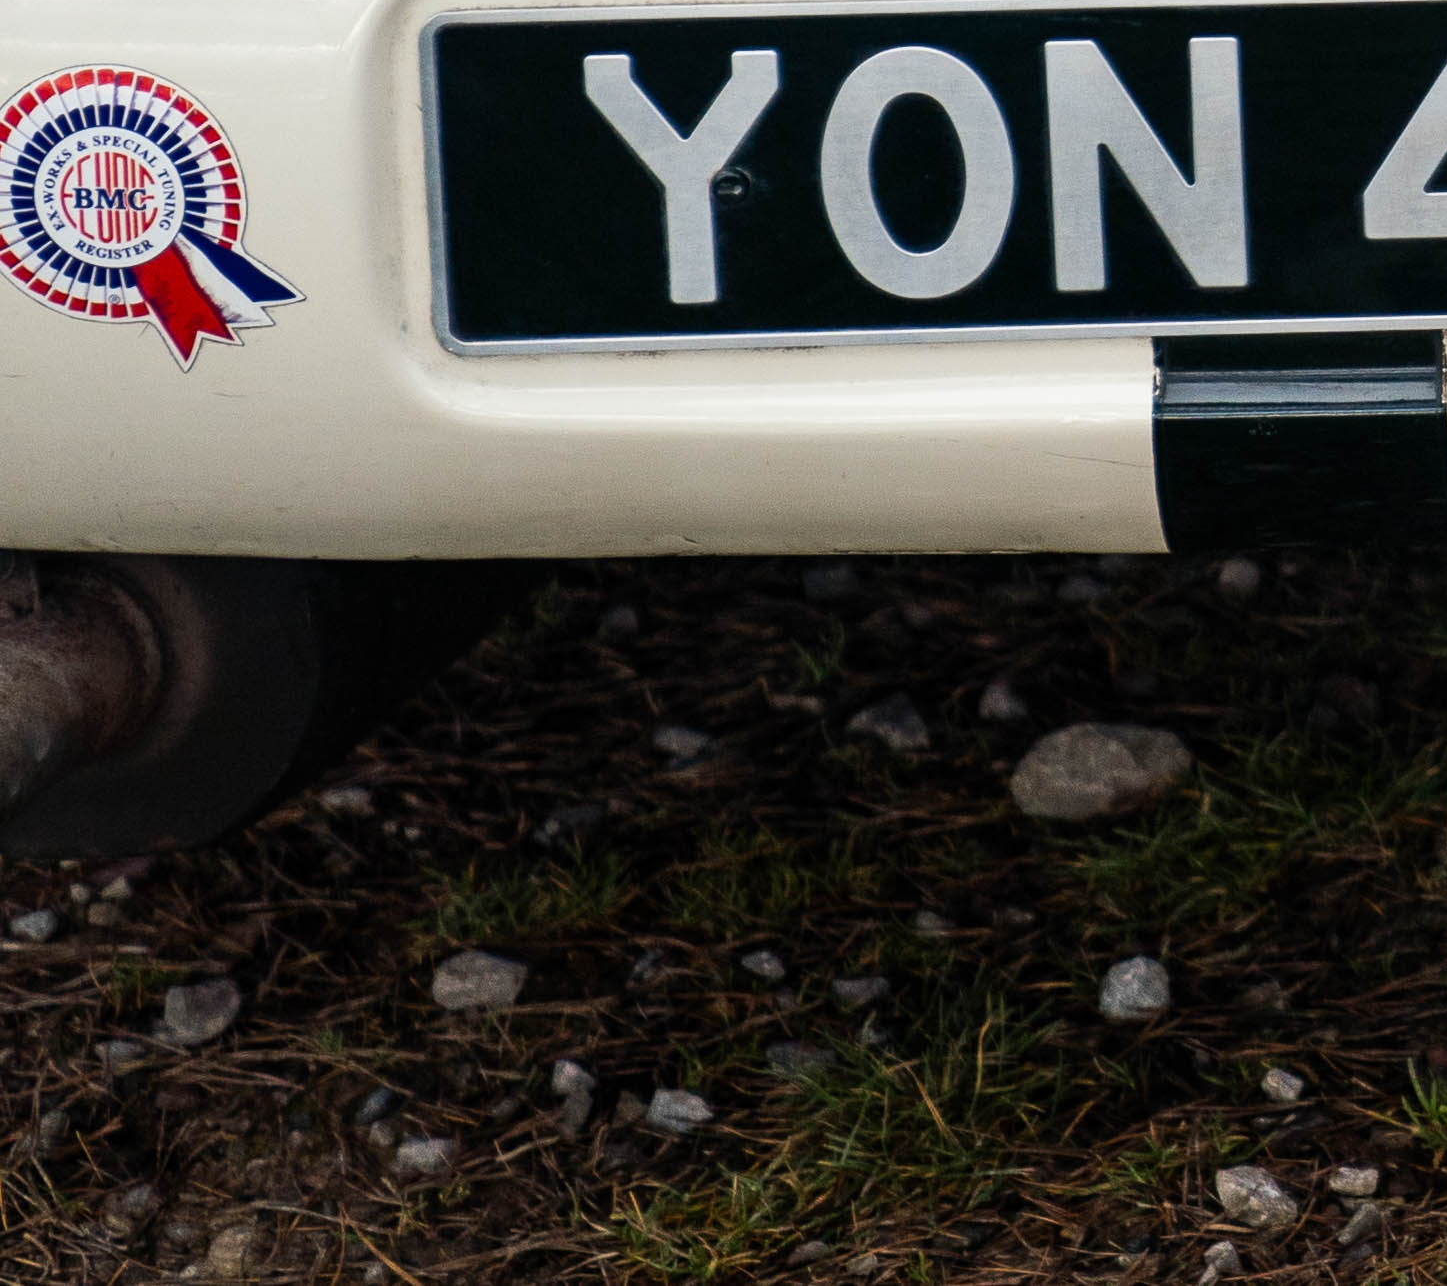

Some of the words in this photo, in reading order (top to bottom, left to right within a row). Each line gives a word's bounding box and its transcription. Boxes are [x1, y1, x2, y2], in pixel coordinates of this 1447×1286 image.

[43, 148, 72, 231] EX-WORKS
[77, 140, 88, 152] &
[92, 135, 158, 168] SPECIAL
[157, 168, 176, 231] TUNING
[72, 187, 148, 211] BMC
[582, 37, 1249, 306] YON
[75, 239, 155, 260] REGISTER
